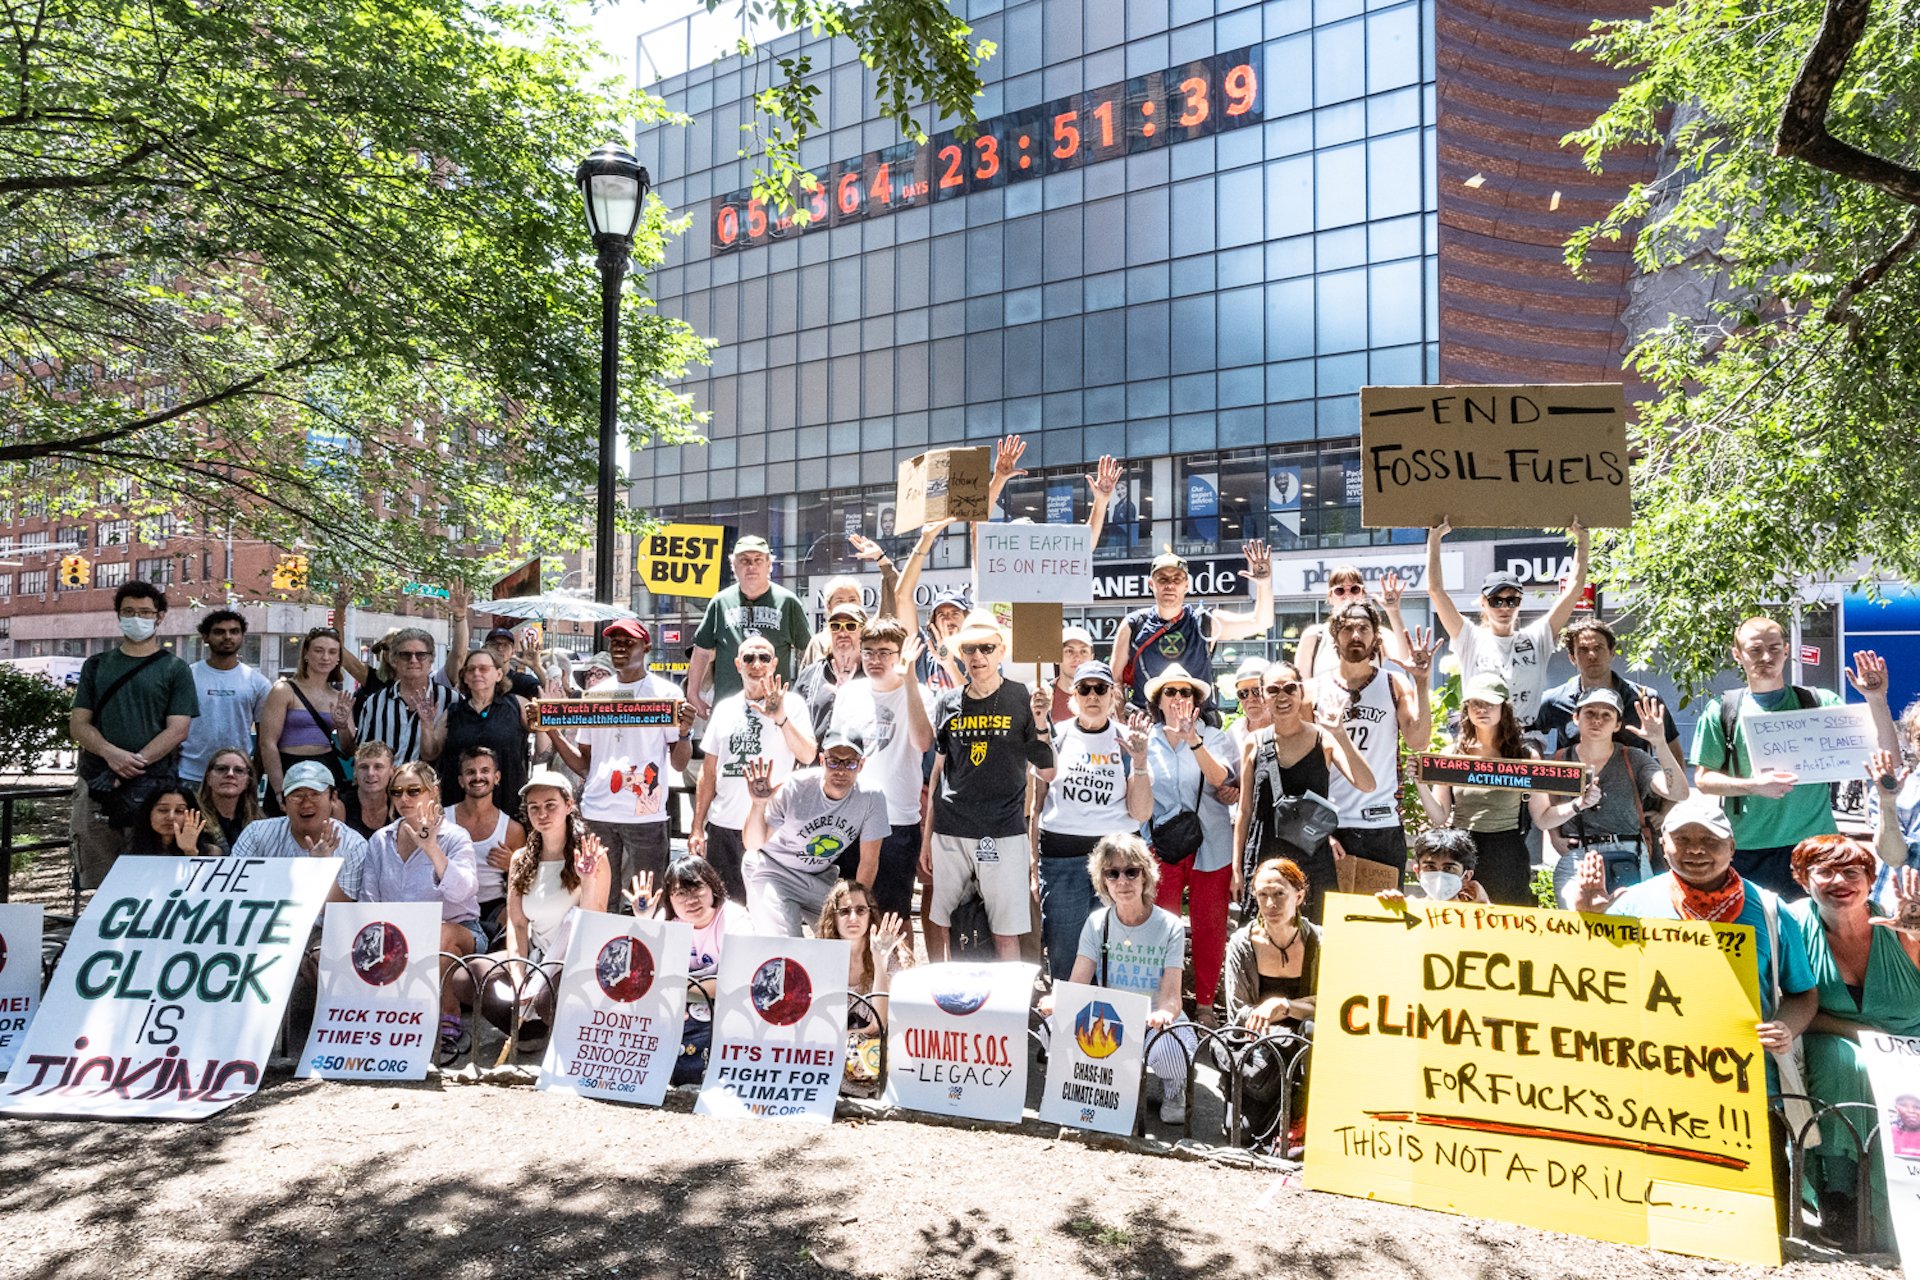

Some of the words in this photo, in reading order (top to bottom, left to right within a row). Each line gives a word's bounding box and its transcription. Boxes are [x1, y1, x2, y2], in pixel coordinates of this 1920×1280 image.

[902, 181, 929, 199] DAYS
[1432, 396, 1541, 424] END
[1370, 444, 1502, 493] FOSSIL
[1504, 449, 1624, 485] FUELS
[650, 536, 718, 560] BEST
[985, 535, 1020, 550] THE
[1030, 535, 1084, 551] EARTH
[651, 561, 710, 585] BUY
[989, 558, 1007, 573] IS
[1013, 558, 1034, 574] ON
[1041, 558, 1088, 576] FIRE!
[1303, 561, 1426, 592] phmacy
[1507, 557, 1574, 584] DUA
[1093, 576, 1138, 598] ANE
[562, 704, 589, 713] Youth
[592, 703, 614, 713] Feel
[617, 703, 672, 714] EcoAnxiety
[950, 715, 1012, 731] SUNRISE
[1754, 720, 1806, 735] DESTROY
[1824, 715, 1864, 728] SYSTEM
[732, 741, 758, 753] PARK
[1763, 740, 1800, 756] SAVE
[1820, 735, 1866, 750] PLANET
[1424, 757, 1430, 767] 5
[1433, 758, 1470, 771] YEARS
[1474, 761, 1494, 772] 365
[1498, 763, 1528, 775] DAYS
[1532, 765, 1581, 779] 23:51:38
[1064, 774, 1114, 791] Action
[1467, 773, 1532, 788] ACTINTIME
[1063, 785, 1112, 806] NOW
[419, 827, 430, 839] 5
[797, 815, 833, 839] THERE
[836, 816, 847, 829] IS
[185, 858, 265, 893] THE
[1425, 907, 1467, 929] HEY
[1473, 908, 1543, 936] POTUS,
[1546, 917, 1581, 935] CAN
[1584, 920, 1616, 940] YOU
[1108, 941, 1166, 955] ALTHY
[76, 950, 282, 1005] CLOCK
[1109, 973, 1159, 989] IMATE
[1423, 951, 1628, 1005] DECLARE
[1644, 969, 1685, 1017] A
[328, 1009, 371, 1025] TICK
[376, 1010, 424, 1026] TOCK
[591, 1010, 652, 1033] DON'T
[317, 1029, 383, 1046] TIME'S
[390, 1032, 424, 1048] UP!
[577, 1026, 615, 1045] HIT
[619, 1031, 659, 1052] THE
[905, 1027, 969, 1064] CLIMATE
[973, 1033, 1013, 1067] S.O.S.
[1875, 1036, 1920, 1056] URG
[577, 1044, 650, 1069] SNOOZE
[721, 1044, 762, 1062] IT'S
[771, 1046, 834, 1066] TIME!
[1551, 1026, 1755, 1094] EMERGENCY
[567, 1061, 649, 1086] BUTTON
[718, 1066, 782, 1084] FIGHT
[788, 1070, 831, 1086] FOR
[919, 1063, 1012, 1088] LEGACY
[1074, 1062, 1113, 1086] CHASE-ING
[1062, 1082, 1095, 1106] CLIMATE
[1092, 1086, 1119, 1111] CHAOS
[1423, 1063, 1485, 1103] FOR
[1485, 1074, 1613, 1122] FUCK'S
[744, 1103, 806, 1116] NYC.ORG
[1334, 1123, 1391, 1161] THIS
[1397, 1129, 1424, 1163] IS
[1435, 1142, 1502, 1177] NOT
[1505, 1151, 1538, 1183] A
